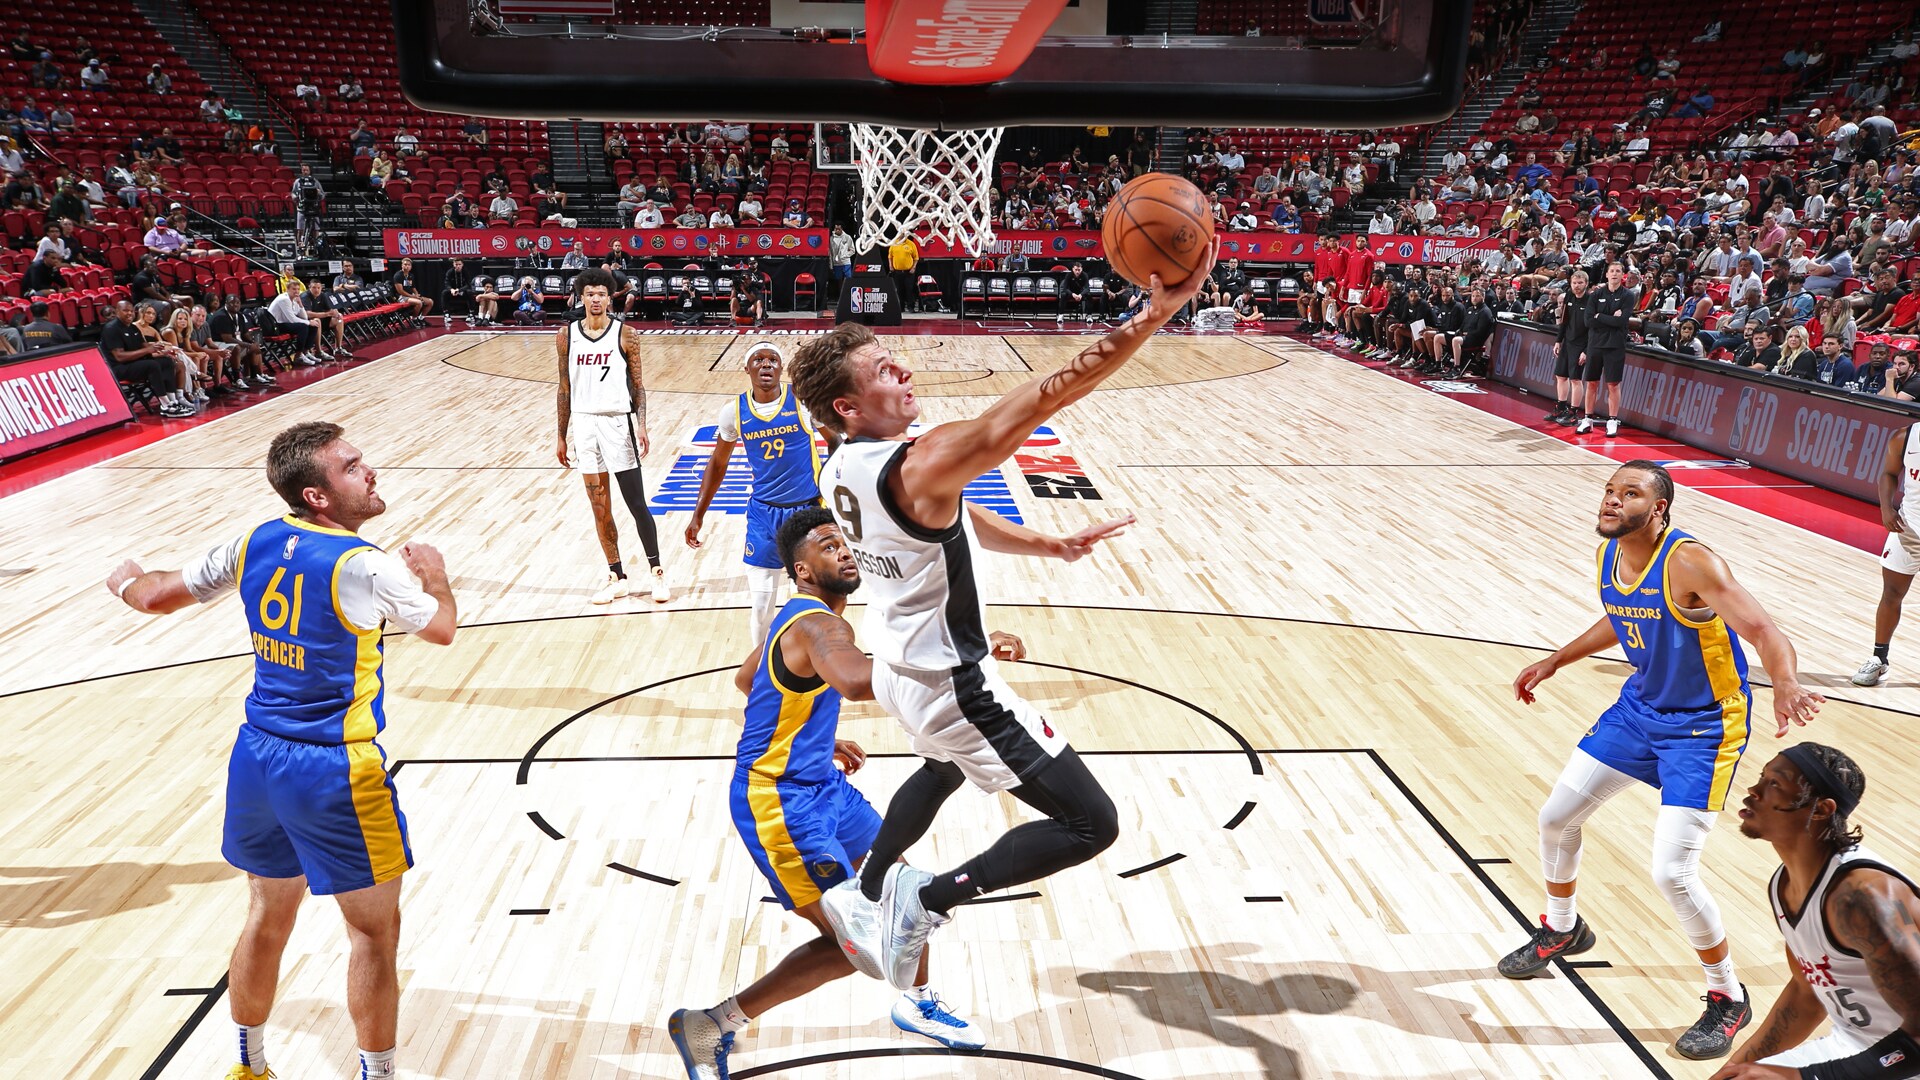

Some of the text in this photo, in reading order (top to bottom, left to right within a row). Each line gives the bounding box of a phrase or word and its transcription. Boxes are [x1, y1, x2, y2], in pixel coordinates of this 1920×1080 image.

[411, 239, 481, 255] SUMMER LEAGUE
[855, 264, 882, 273] 2K25
[864, 292, 888, 303] SUMMER
[864, 303, 884, 313] LEAGUE
[577, 349, 614, 366] HEAT
[599, 366, 611, 382] 7
[30, 363, 108, 427] LEAGUE
[1660, 375, 1725, 435] LEAGUE
[743, 423, 800, 441] WARRIORS
[1786, 406, 1862, 476] SCORE
[760, 438, 786, 460] 29
[852, 548, 904, 579] RSSON
[258, 565, 304, 637] 61
[1604, 601, 1663, 620] WARRIORS
[1621, 620, 1646, 650] 31
[252, 631, 305, 671] SPENCER
[1825, 987, 1873, 1028] 15
